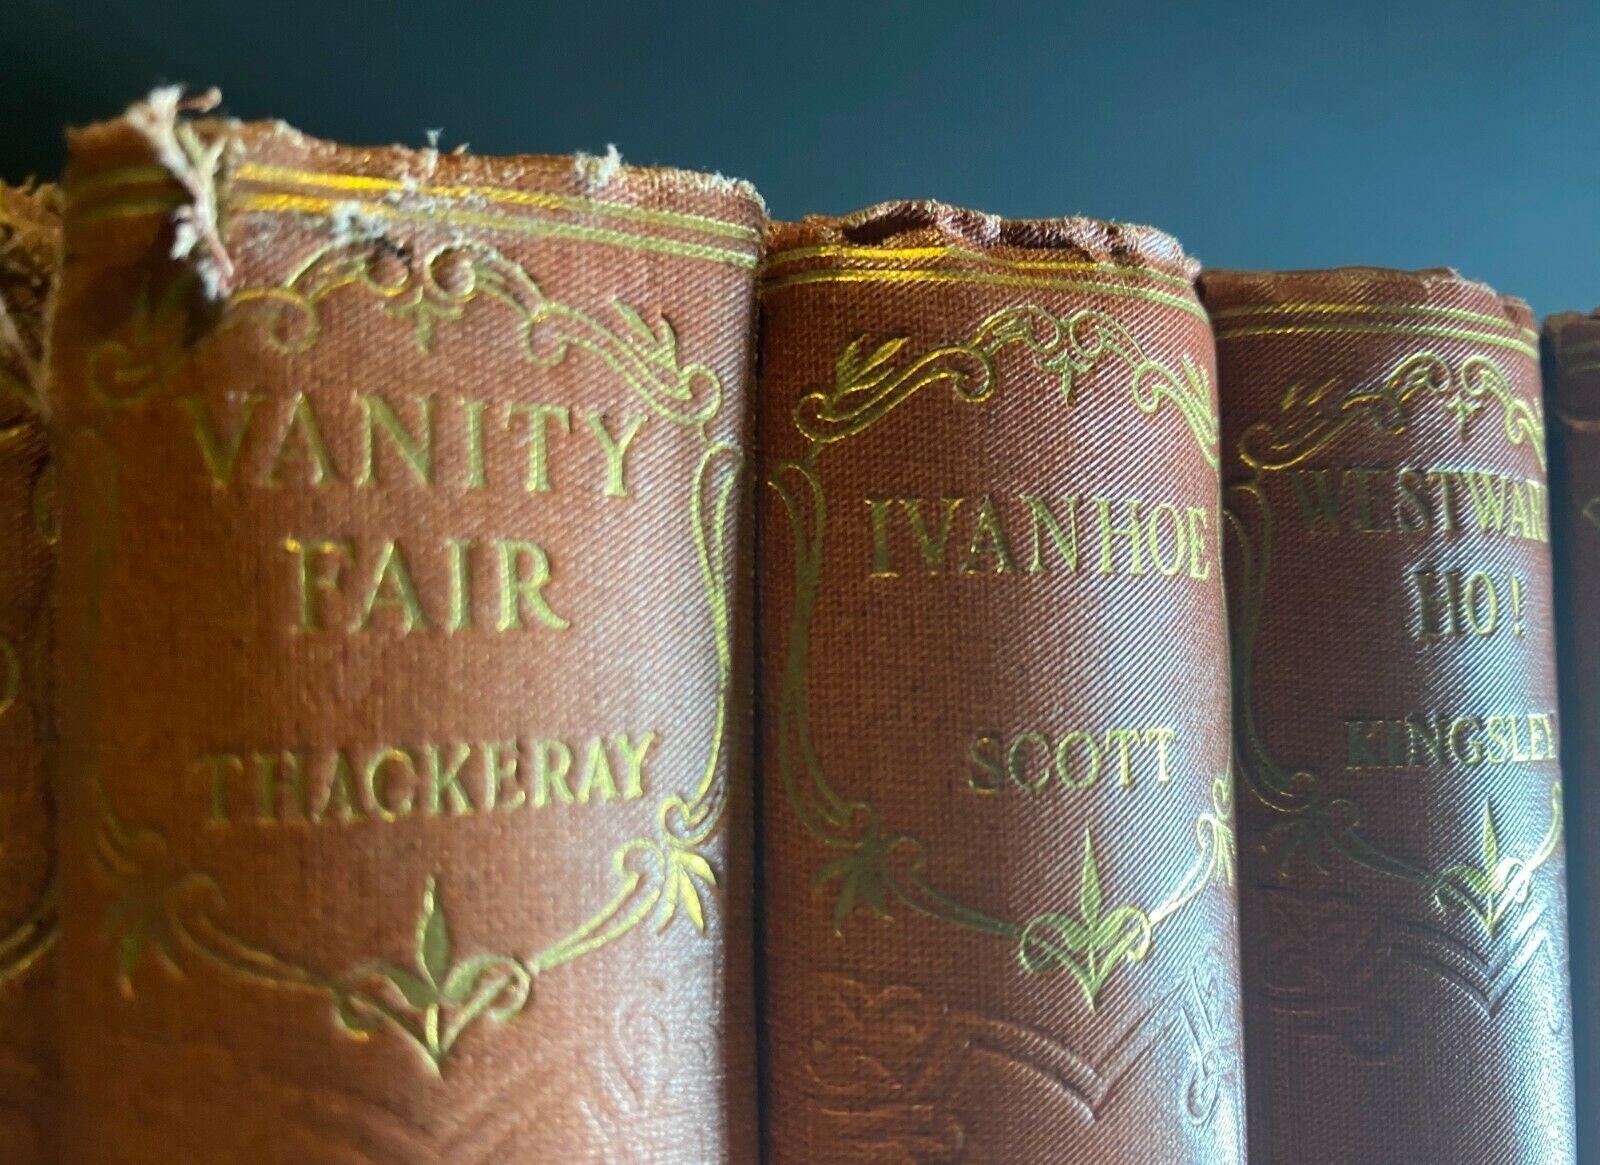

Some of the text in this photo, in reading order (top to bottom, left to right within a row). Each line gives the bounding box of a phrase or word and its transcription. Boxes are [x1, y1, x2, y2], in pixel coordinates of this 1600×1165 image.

[184, 388, 648, 498] VANITY
[284, 536, 571, 637] FAIR
[865, 494, 1210, 582] IVANHOE
[195, 730, 660, 827] THACKERAY
[968, 724, 1176, 796] SCOTT
